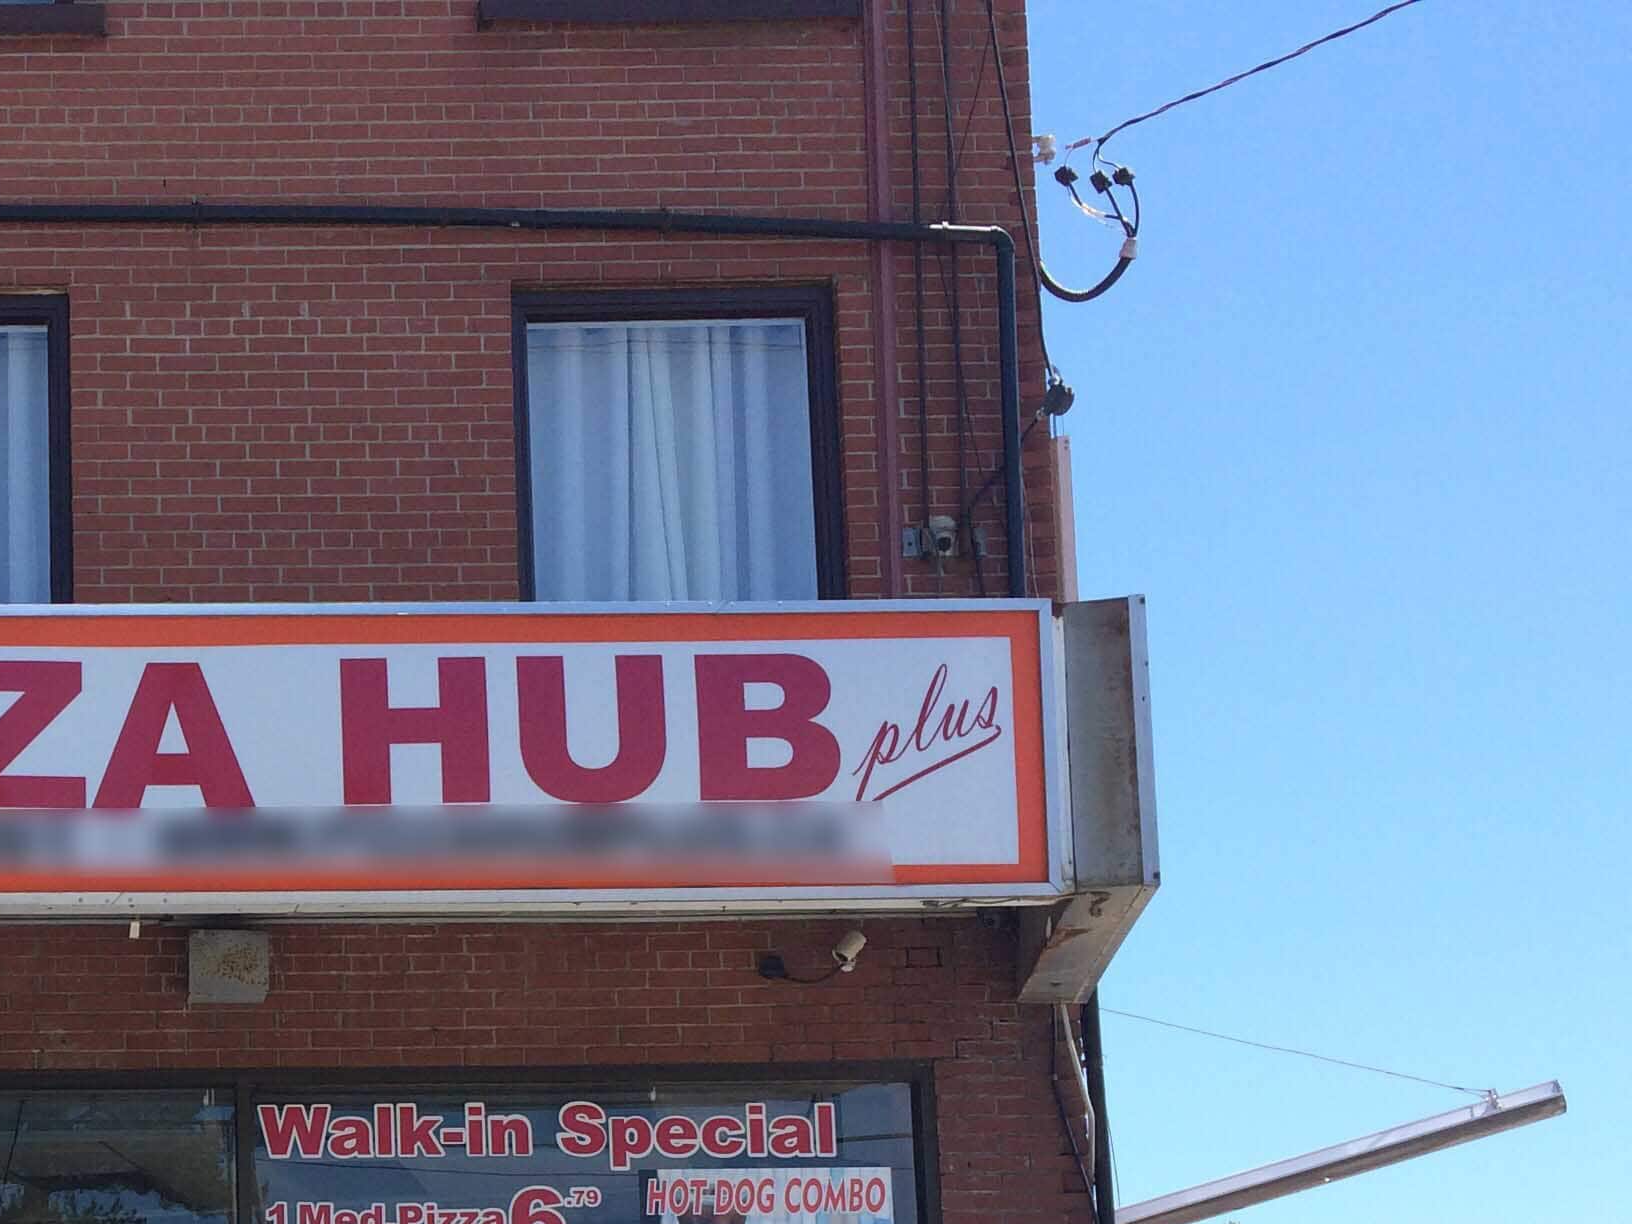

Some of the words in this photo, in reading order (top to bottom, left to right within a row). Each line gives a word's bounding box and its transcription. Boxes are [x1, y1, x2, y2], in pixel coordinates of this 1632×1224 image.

[340, 653, 841, 804] HUB
[852, 663, 1002, 802] plus
[257, 1103, 533, 1158] Walk-in
[557, 1101, 837, 1170] Special
[646, 1177, 709, 1216] HOT
[713, 1177, 776, 1215] DOG
[784, 1175, 887, 1214] COMBO
